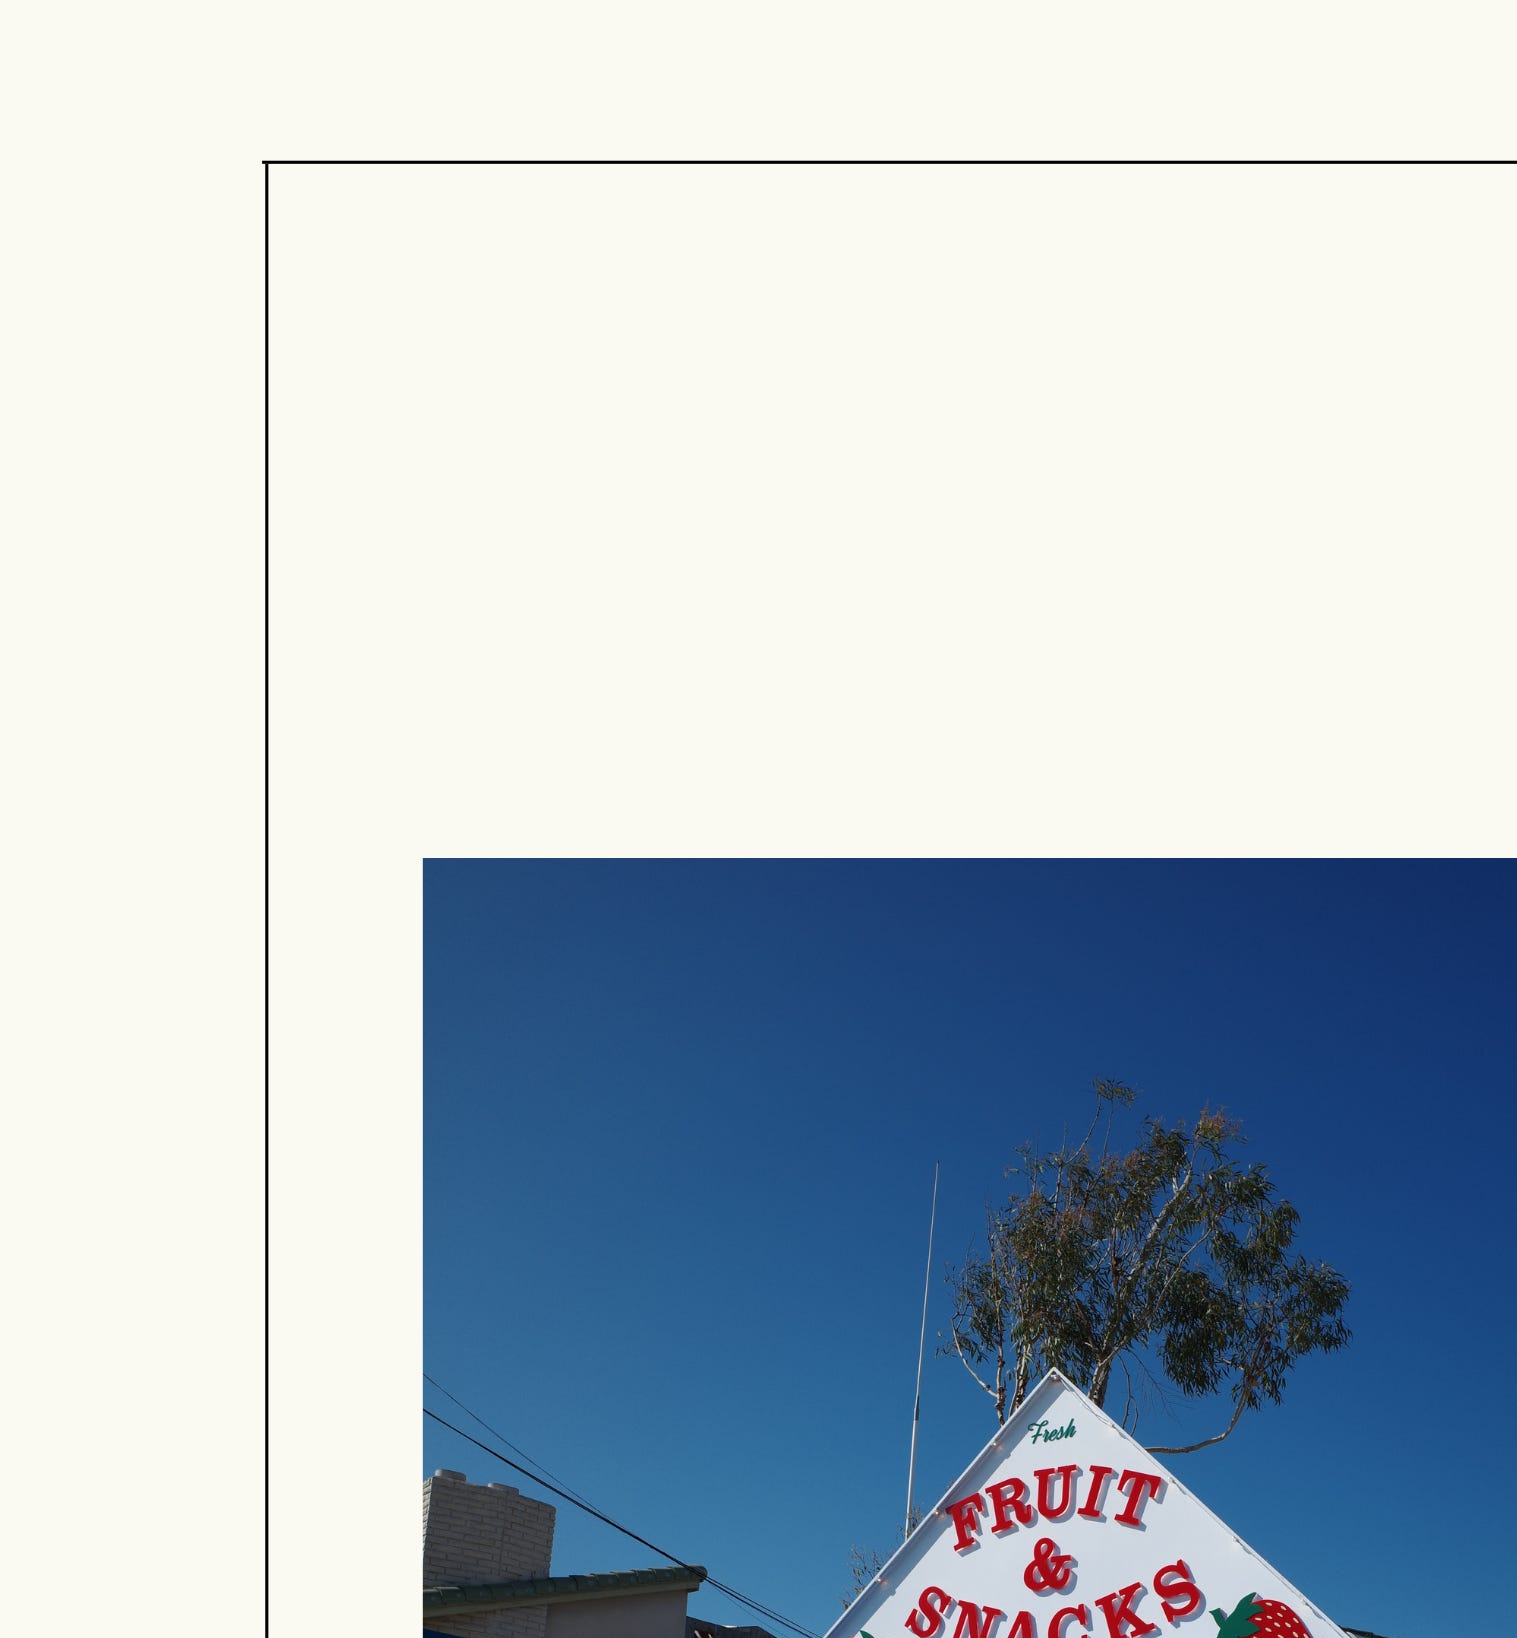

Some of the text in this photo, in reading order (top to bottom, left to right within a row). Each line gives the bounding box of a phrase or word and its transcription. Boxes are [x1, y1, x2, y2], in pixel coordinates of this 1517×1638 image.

[1027, 1418, 1076, 1445] Fresh
[944, 1463, 1163, 1553] FRUIT
[1023, 1537, 1073, 1592] &
